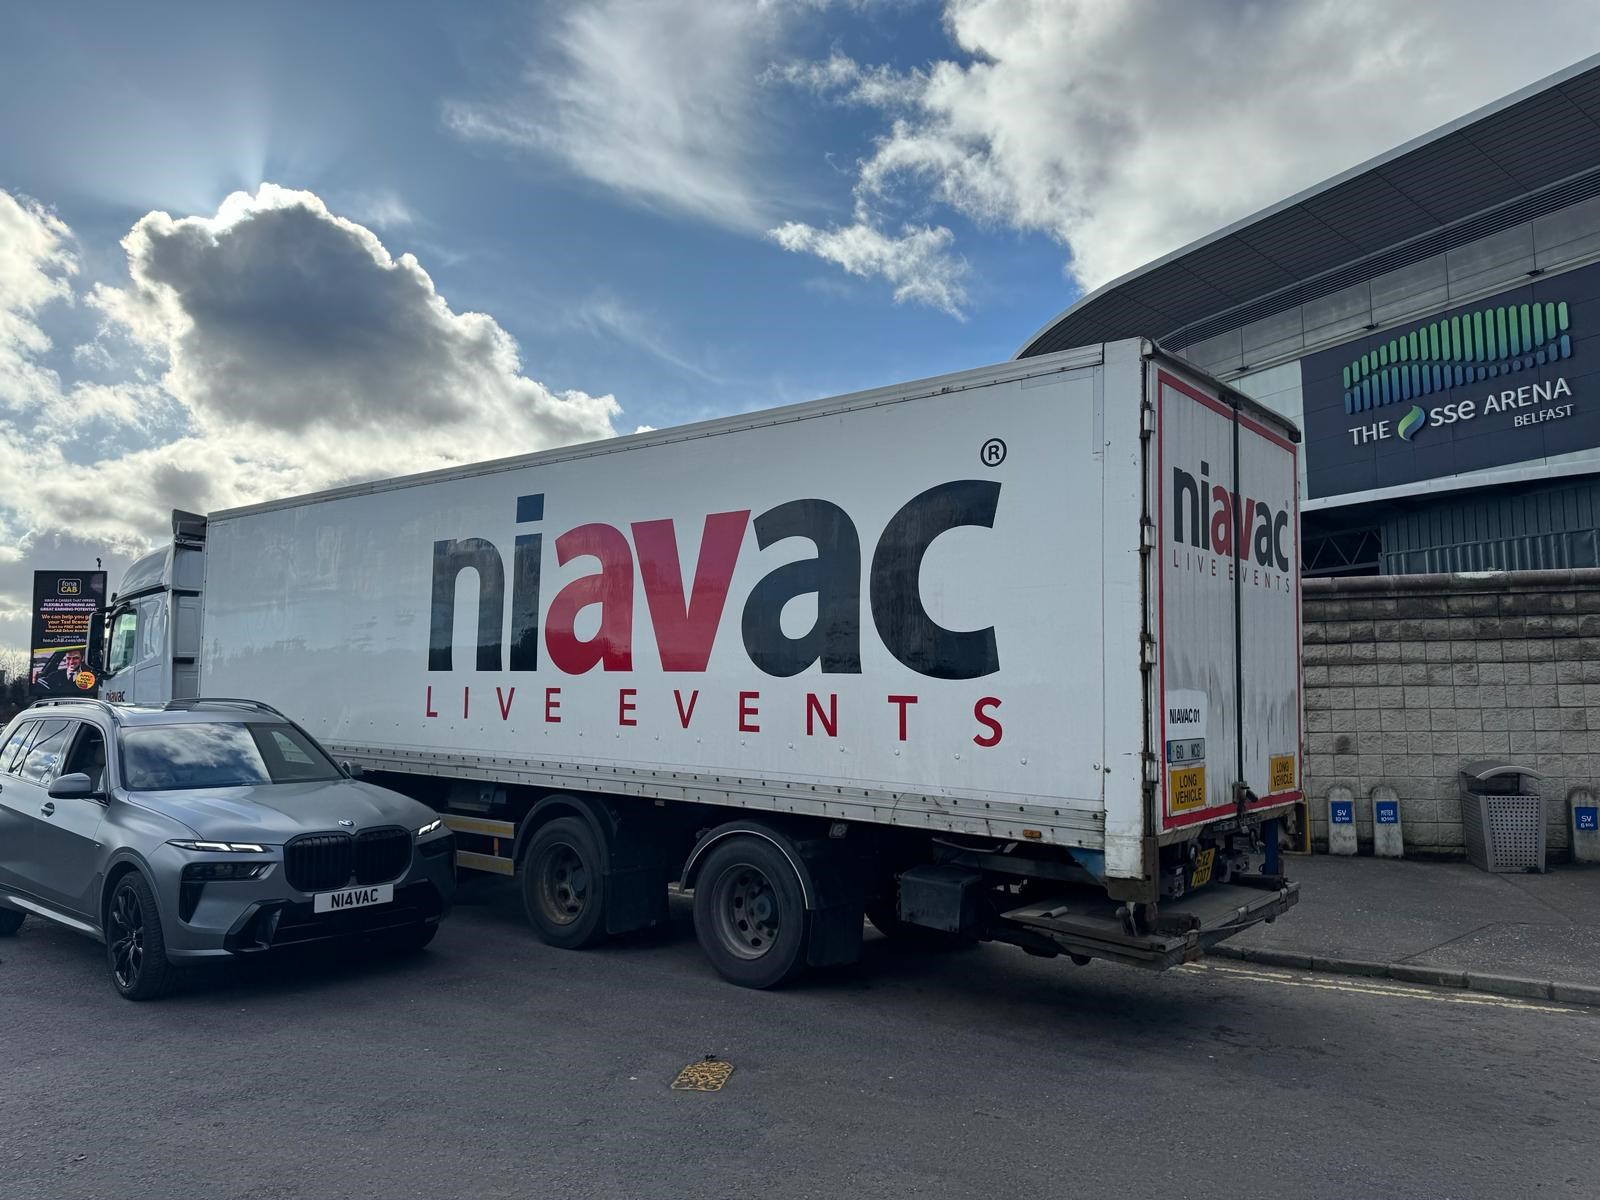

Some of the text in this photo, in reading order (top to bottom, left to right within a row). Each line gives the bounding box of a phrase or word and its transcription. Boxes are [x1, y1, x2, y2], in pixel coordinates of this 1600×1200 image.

[1348, 420, 1392, 445] THE
[1483, 377, 1573, 415] ARENA
[1514, 403, 1575, 427] BELFAST
[1173, 460, 1289, 573] niavac
[428, 479, 1002, 680] niavac
[1173, 549, 1290, 593] LIVE EVENTS
[106, 690, 126, 702] niavac
[426, 686, 1003, 747] LIVE EVENTS
[1169, 708, 1200, 724] NIAVAC 01
[1276, 760, 1290, 773] LONG
[1180, 774, 1197, 788] LONG
[1273, 772, 1292, 786] VEHICLE
[1175, 788, 1202, 804] VEHICLE
[331, 888, 379, 909] N14VAC
